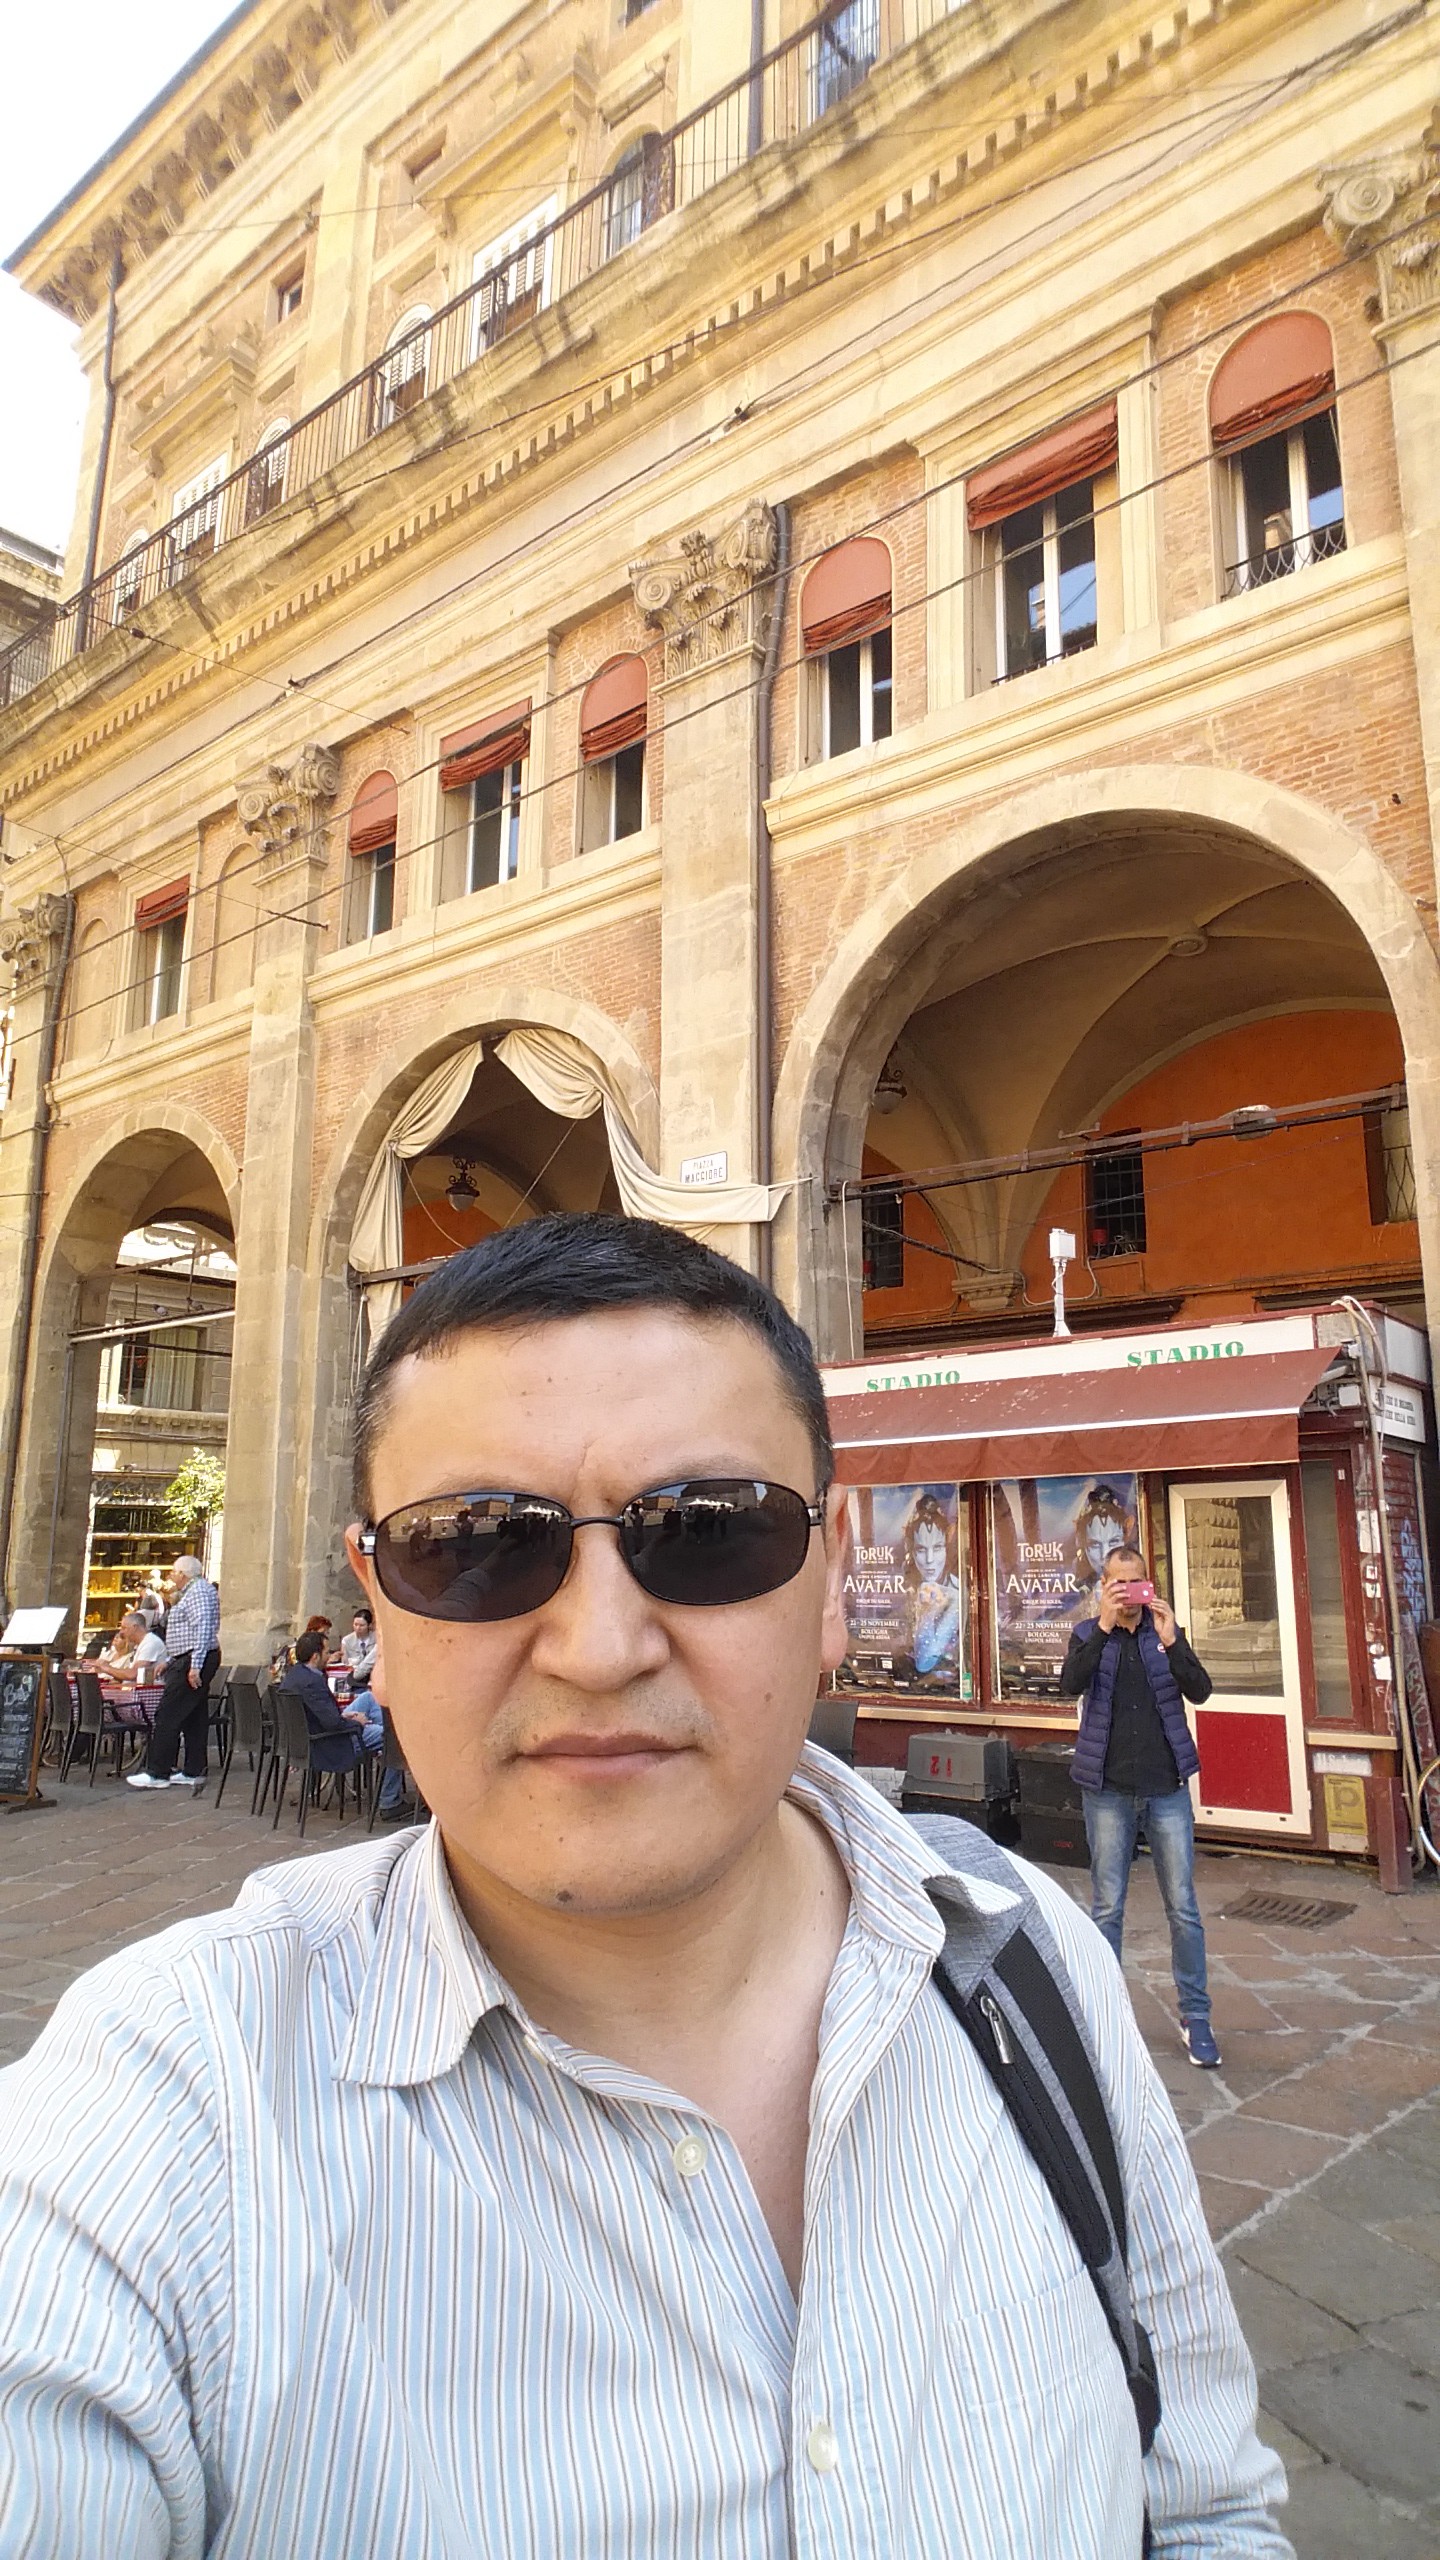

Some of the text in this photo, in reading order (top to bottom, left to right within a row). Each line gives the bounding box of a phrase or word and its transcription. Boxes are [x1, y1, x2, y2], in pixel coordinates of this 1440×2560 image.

[693, 1160, 713, 1169] PIAZZA
[685, 1167, 722, 1183] MAGGIORE
[1126, 1341, 1244, 1366] STADIO
[866, 1370, 961, 1393] STADIO
[853, 1545, 895, 1564] TORUK
[1017, 1542, 1063, 1561] TORUK
[843, 1575, 906, 1593] AVATAR
[1005, 1573, 1080, 1593] AVATAR
